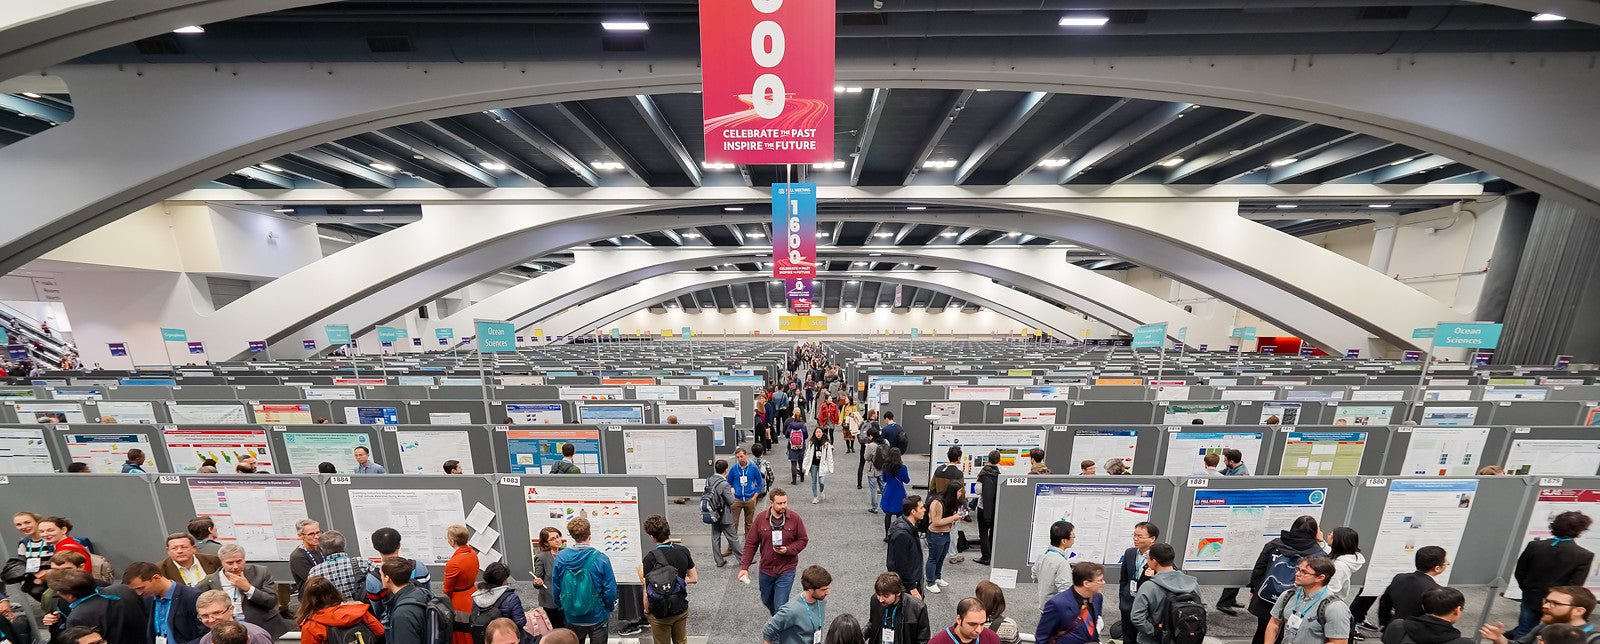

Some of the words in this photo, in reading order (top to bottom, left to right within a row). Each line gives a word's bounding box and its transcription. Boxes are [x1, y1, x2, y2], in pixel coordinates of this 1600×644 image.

[751, 0, 786, 119] 00
[723, 129, 779, 138] CELEBRATE
[791, 129, 817, 138] PAST
[723, 141, 763, 150] INSPIRE
[775, 141, 816, 150] FUTURE
[790, 199, 800, 264] 1600
[488, 327, 505, 336] Ocean
[1454, 327, 1481, 335] Ocean
[485, 339, 508, 348] Sciences
[1446, 336, 1482, 345] Sciences
